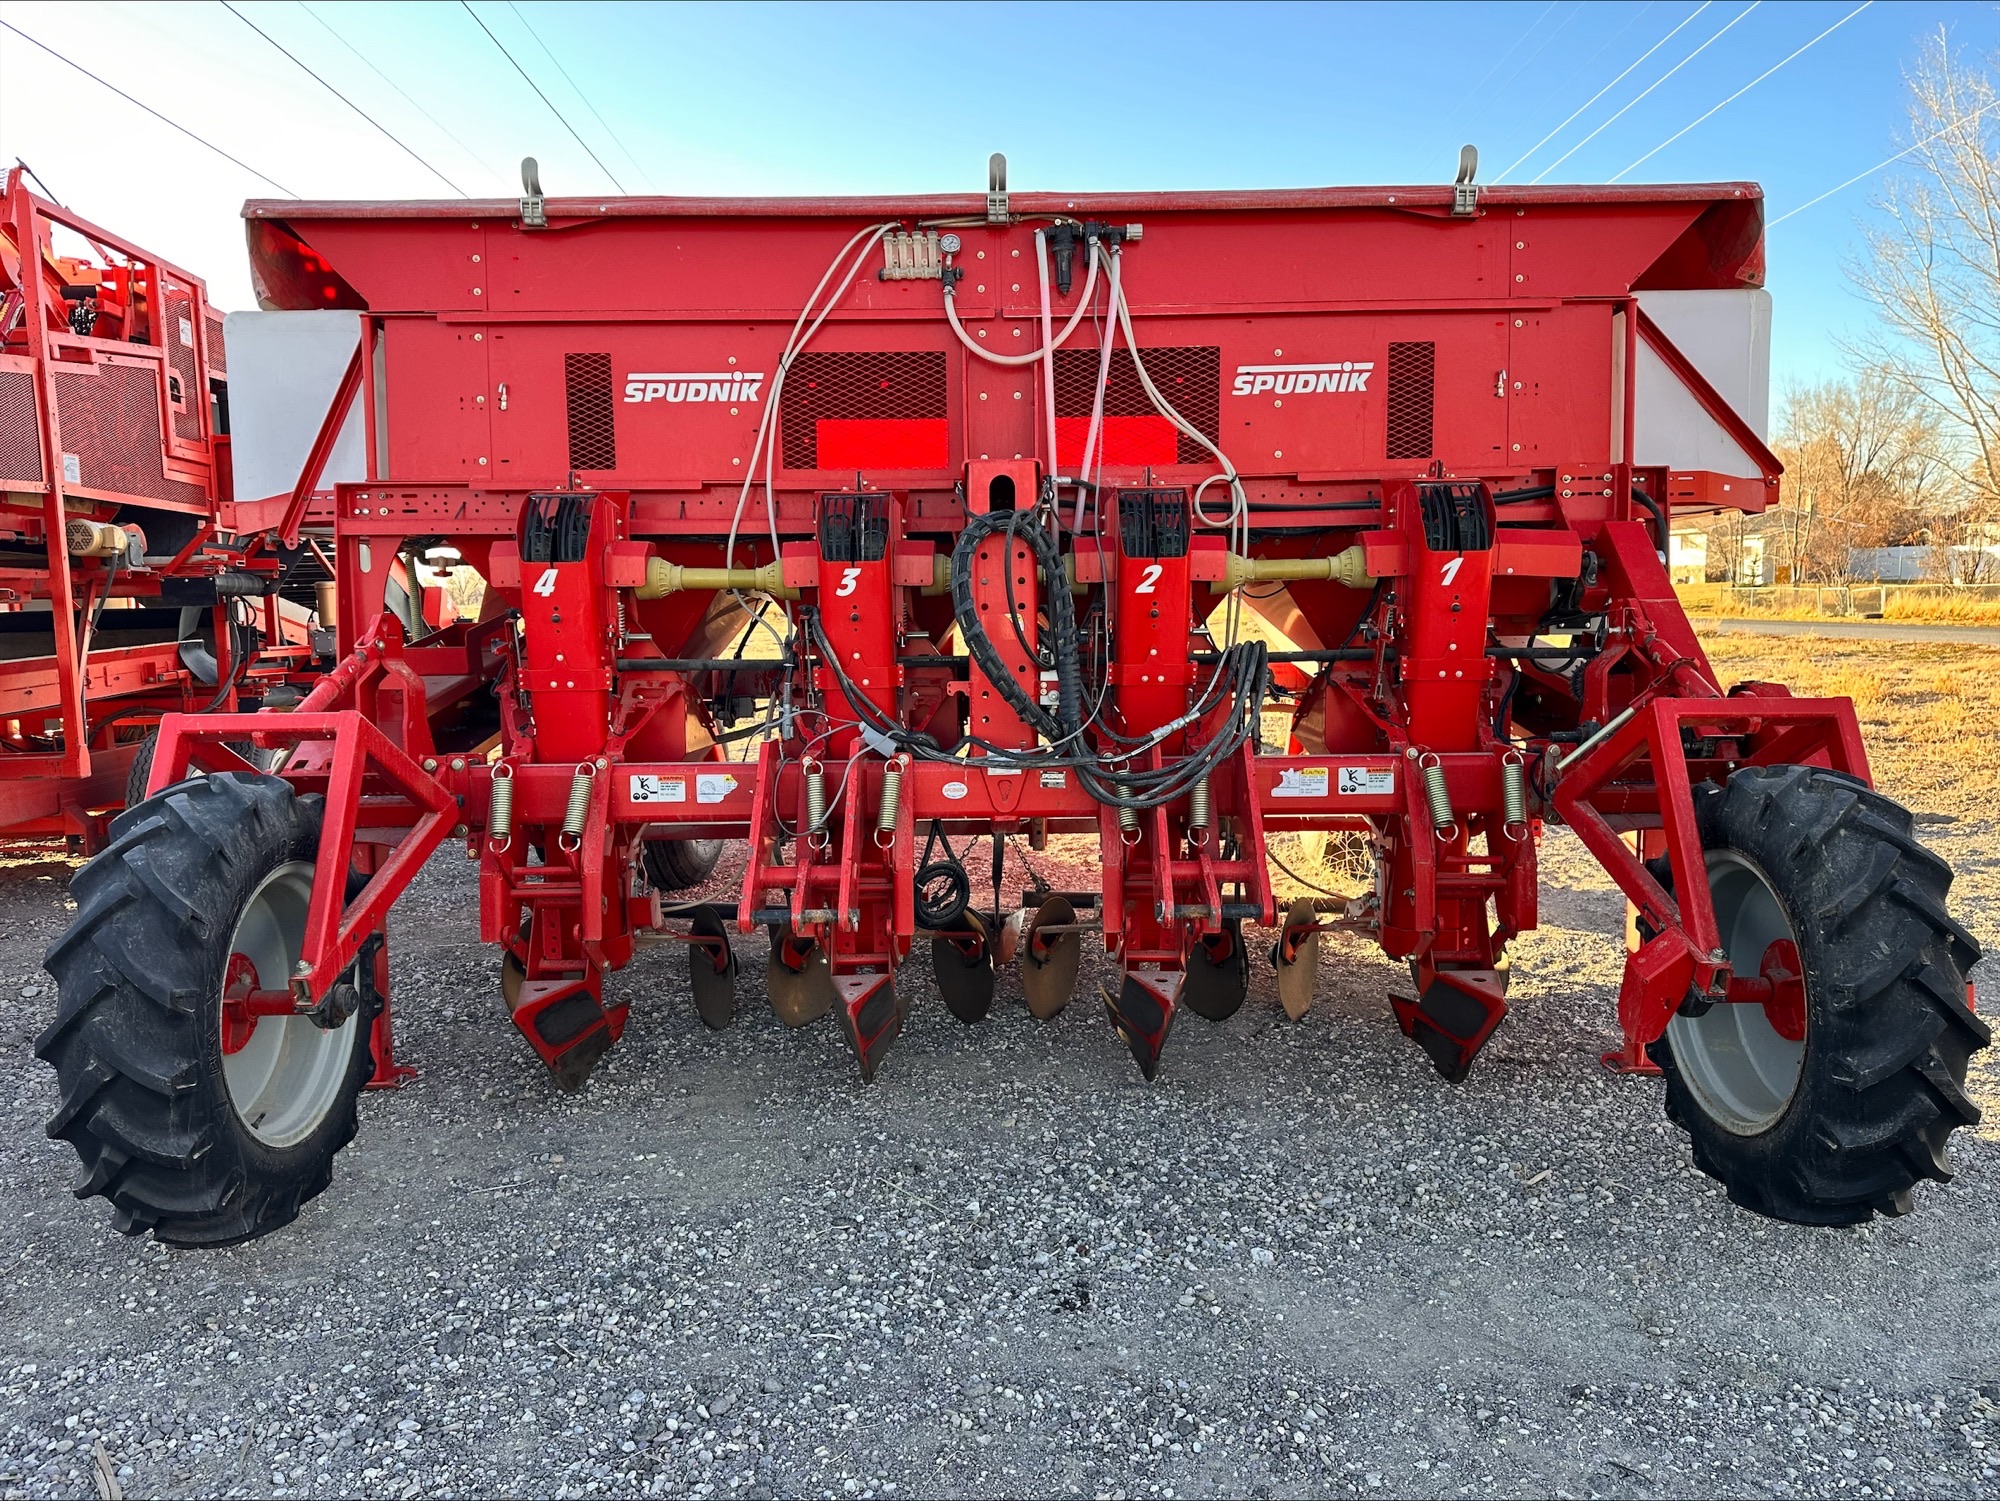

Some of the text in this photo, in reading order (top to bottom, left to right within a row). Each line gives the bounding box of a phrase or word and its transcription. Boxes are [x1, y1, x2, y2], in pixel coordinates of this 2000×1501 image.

[532, 568, 559, 597] 4
[835, 567, 862, 596] 3
[1134, 564, 1163, 593] 2
[1440, 557, 1465, 586] 1
